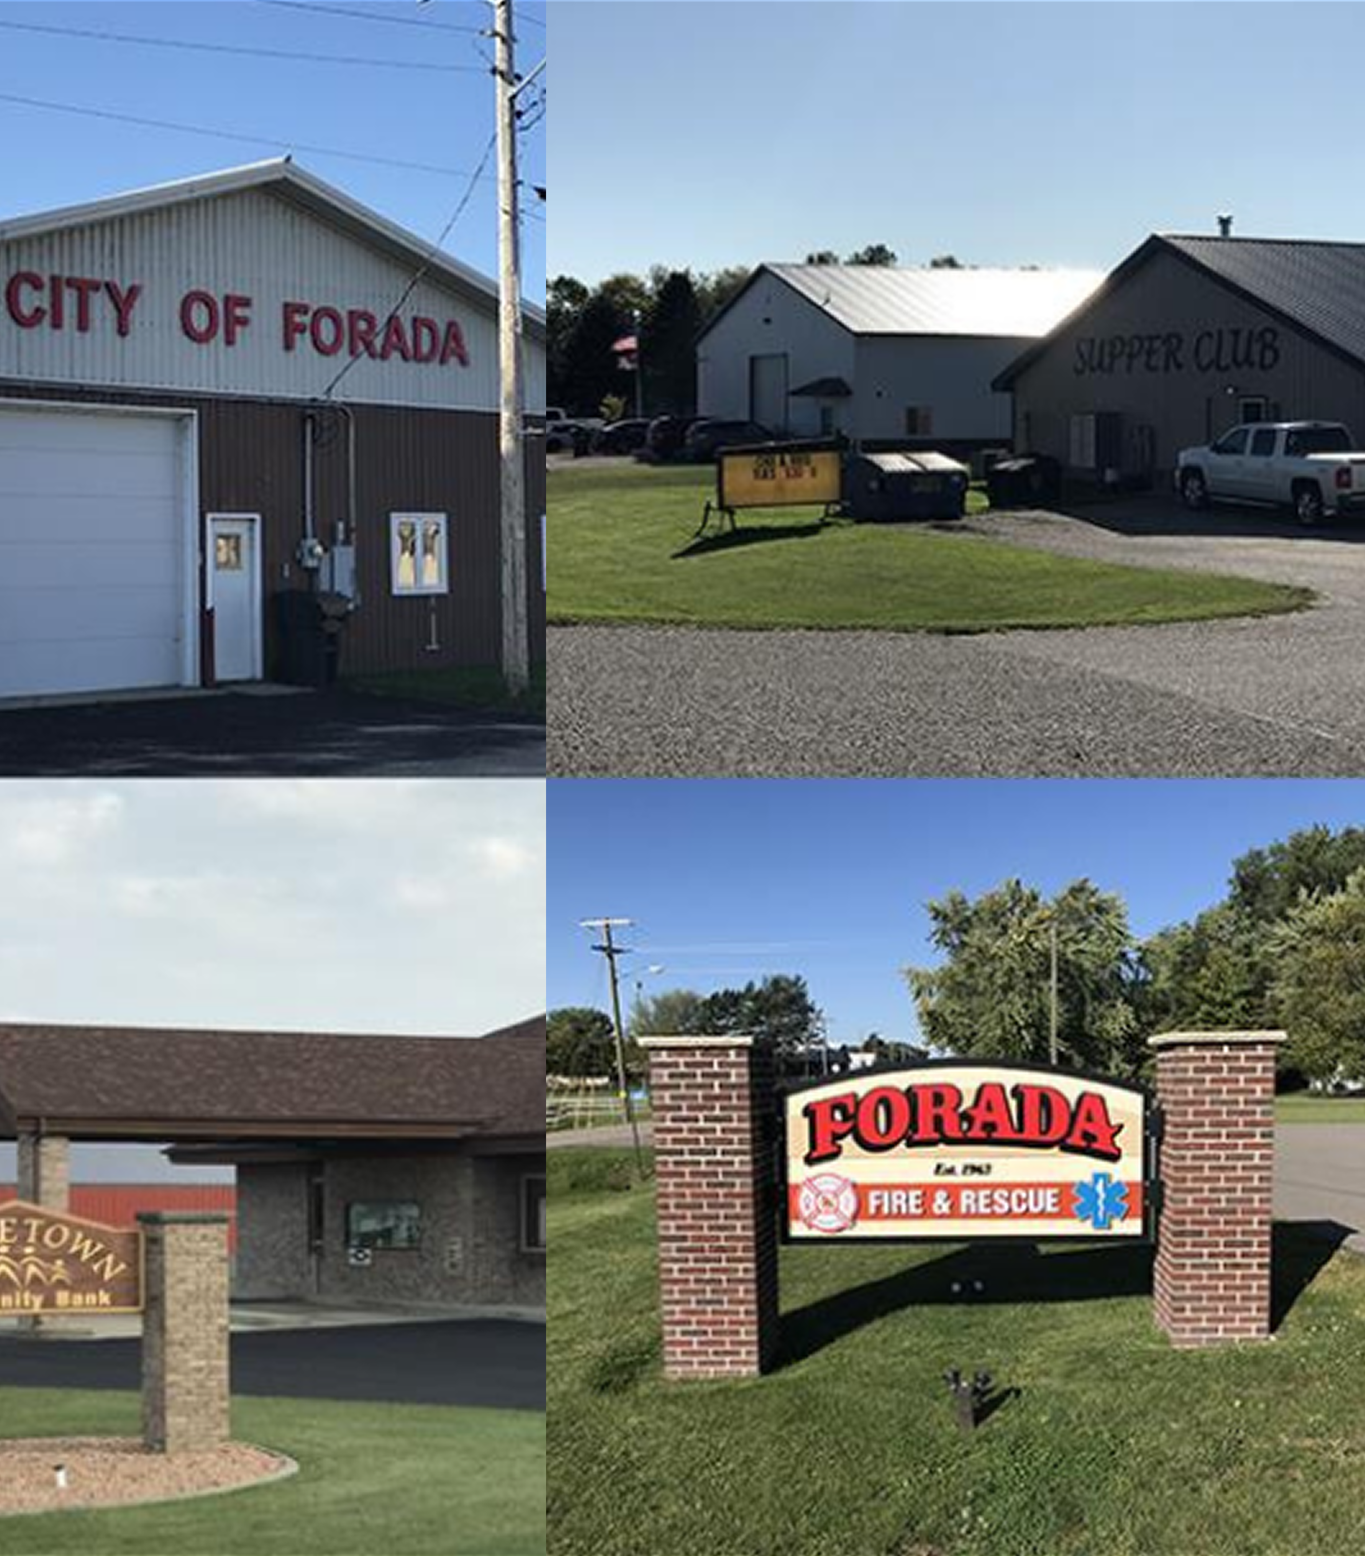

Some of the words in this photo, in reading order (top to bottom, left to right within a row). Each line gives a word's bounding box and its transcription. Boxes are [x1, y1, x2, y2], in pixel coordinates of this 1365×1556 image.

[4, 270, 142, 338] CITY
[179, 289, 253, 347] OF
[282, 301, 470, 368] FORADA
[1073, 331, 1184, 376] SUPPER
[1194, 326, 1280, 373] CLUB
[803, 1082, 1124, 1167] FORADA
[868, 1188, 924, 1216] FIRE
[933, 1190, 954, 1215] &
[959, 1187, 1060, 1214] RESCUE
[55, 1289, 113, 1308] Bank
